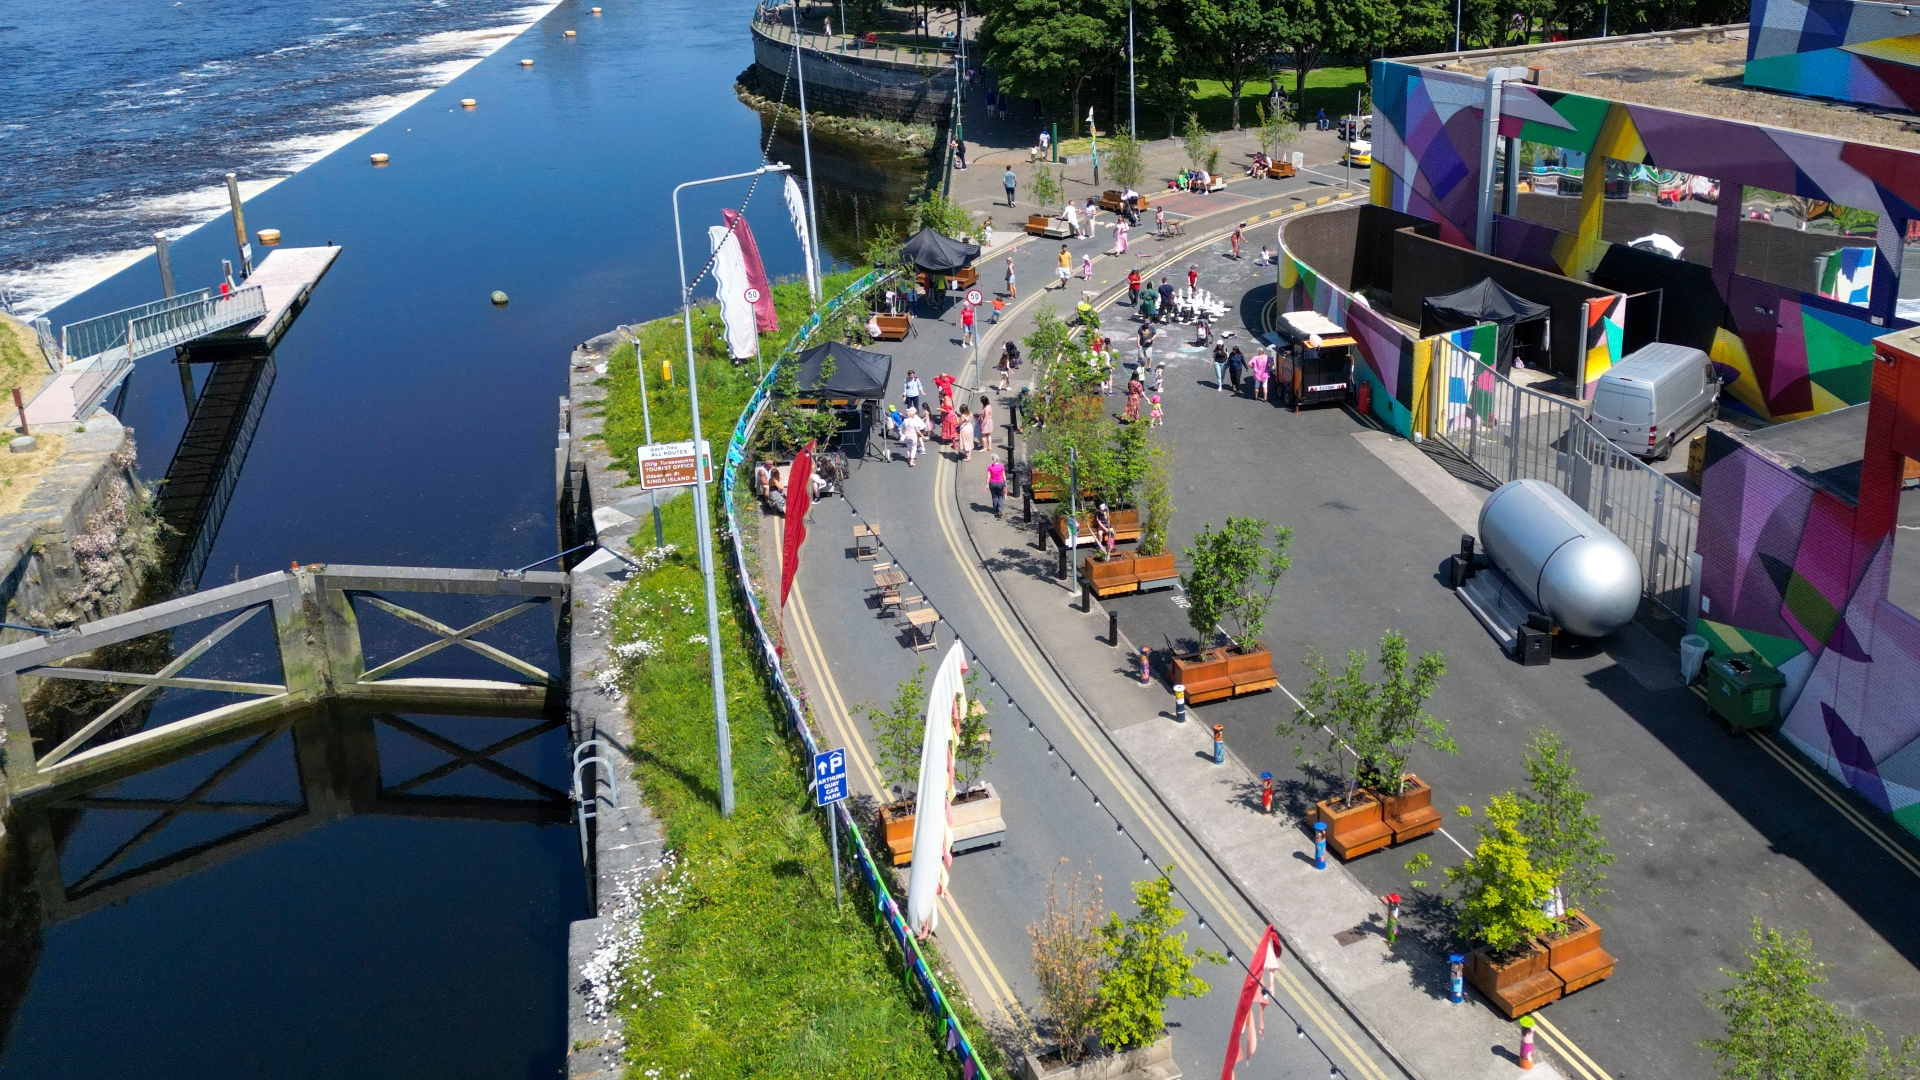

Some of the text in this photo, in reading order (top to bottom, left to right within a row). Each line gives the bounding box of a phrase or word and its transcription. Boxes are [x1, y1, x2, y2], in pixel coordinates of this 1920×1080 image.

[830, 756, 842, 774] P
[818, 773, 845, 785] ARTHURS
[824, 781, 839, 790] QUAY
[824, 792, 841, 802] PARK
